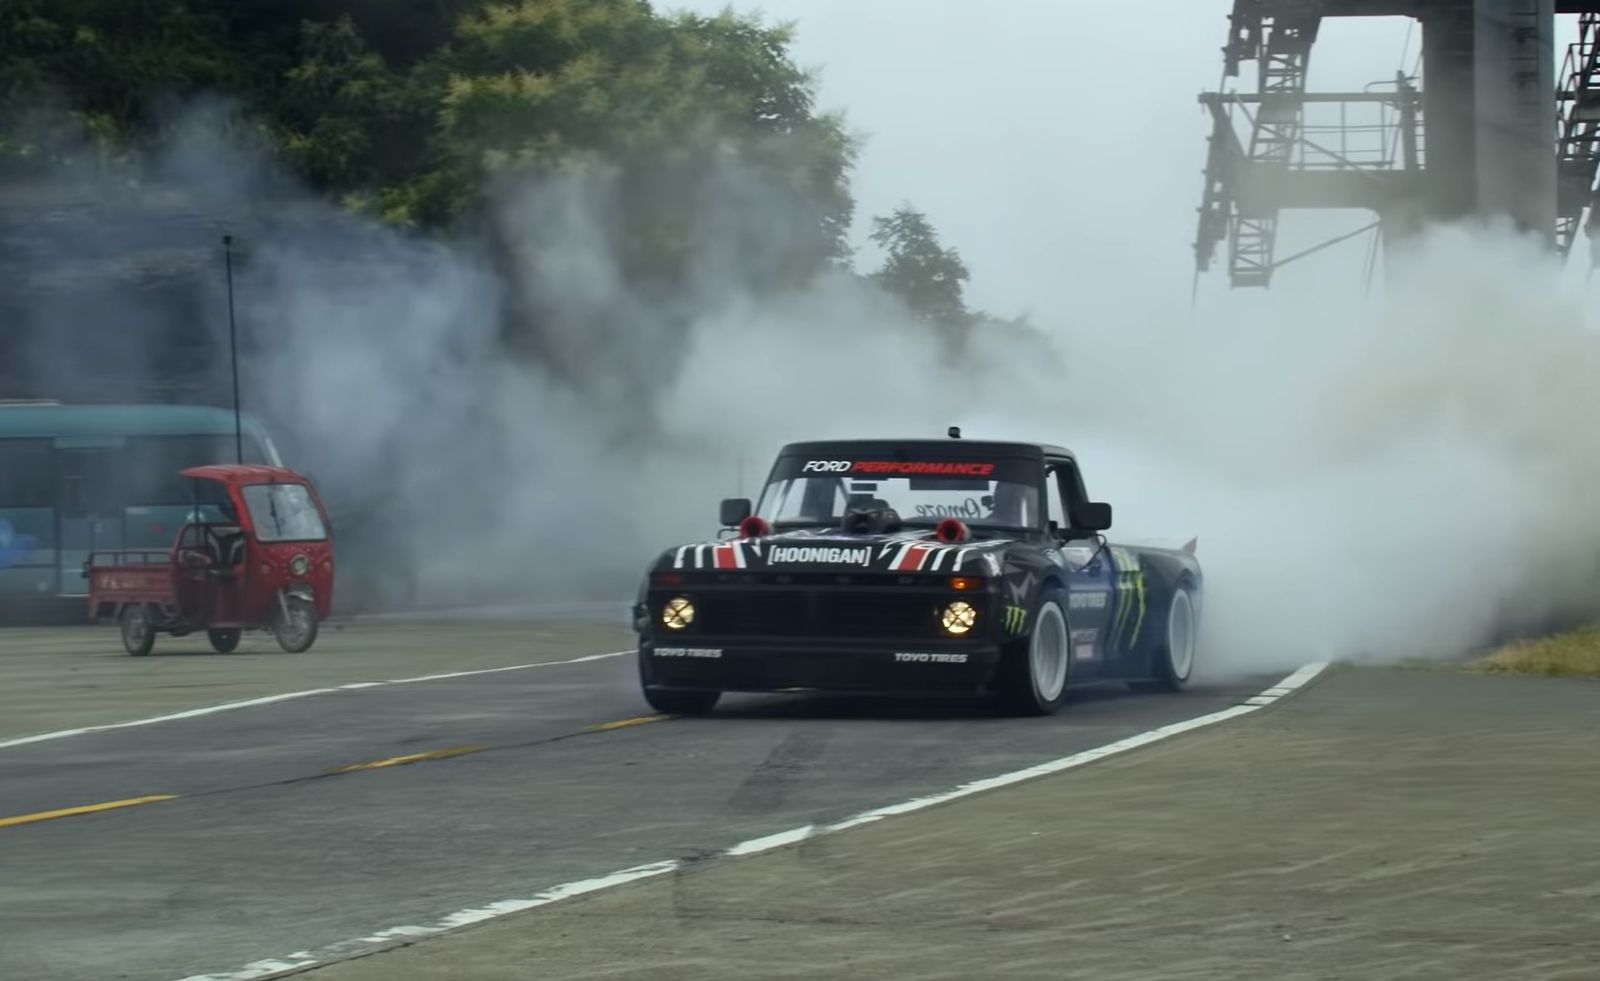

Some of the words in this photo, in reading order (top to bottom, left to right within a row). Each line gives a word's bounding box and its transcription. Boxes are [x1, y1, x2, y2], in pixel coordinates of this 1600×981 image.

[802, 460, 852, 473] FORD
[852, 461, 995, 476] PERFORMANCE
[653, 648, 686, 657] TOYO
[686, 648, 723, 658] TIRES
[895, 653, 929, 662] TOYO
[930, 653, 968, 663] TIRES
